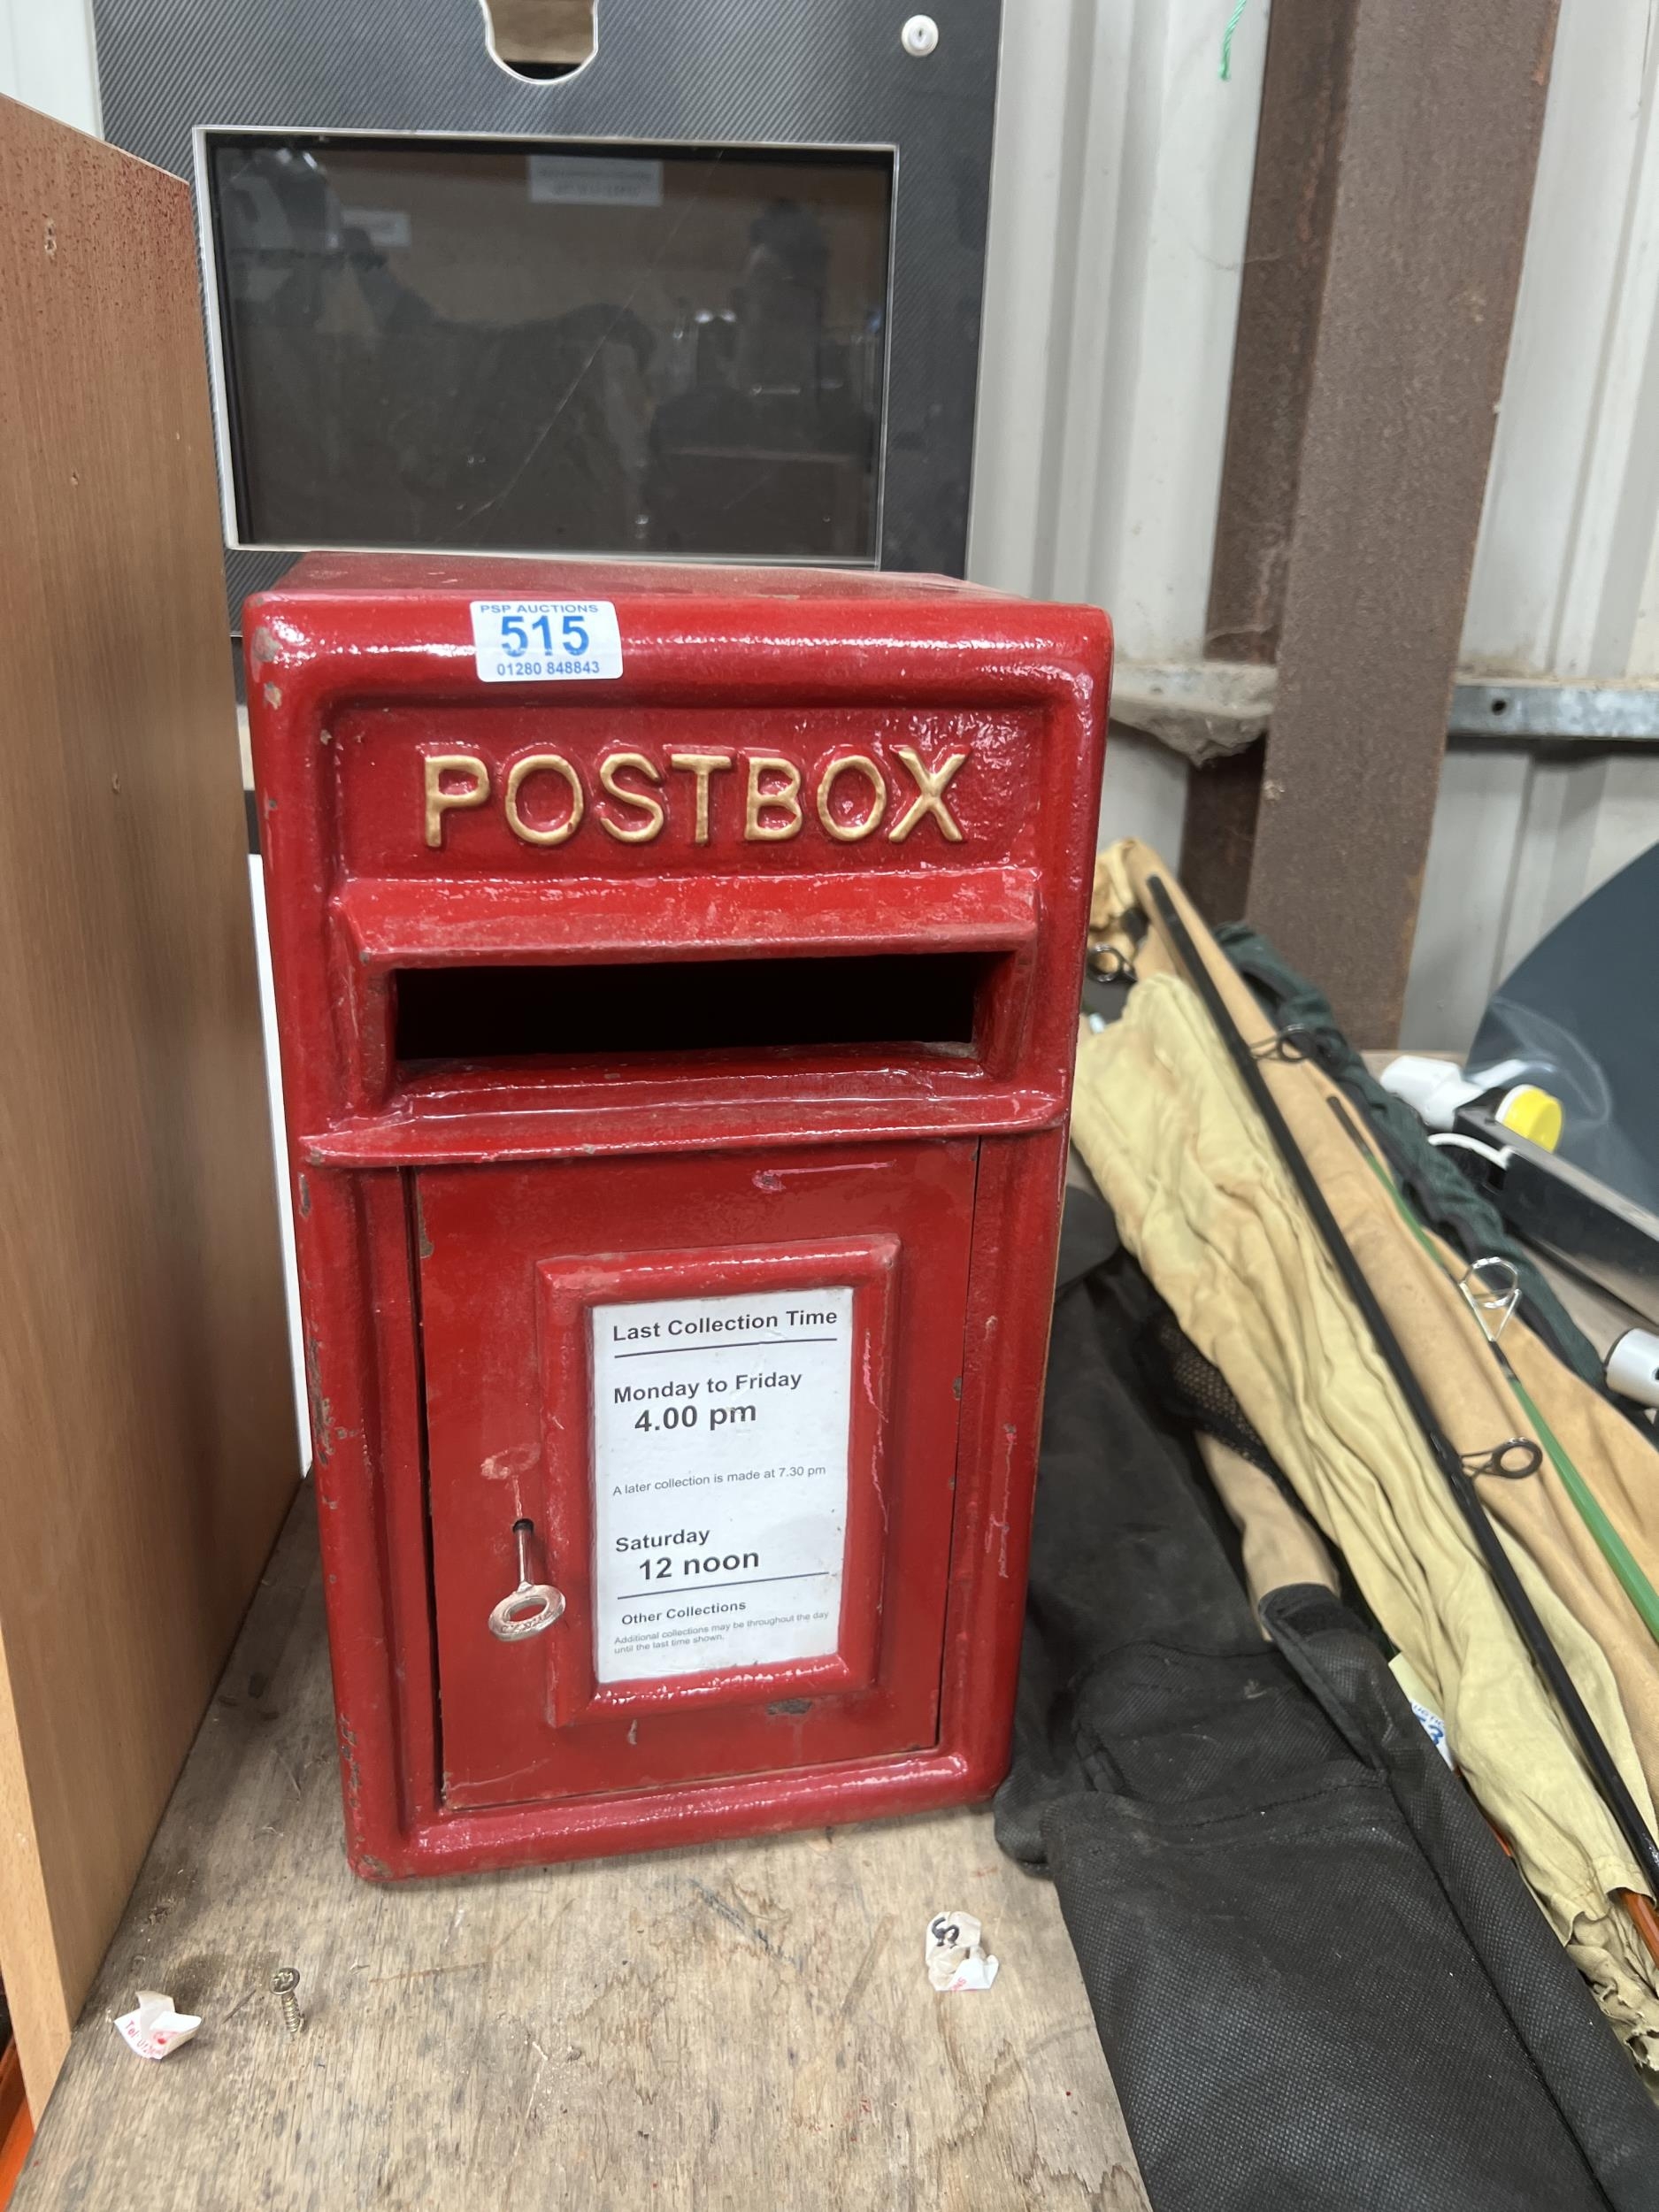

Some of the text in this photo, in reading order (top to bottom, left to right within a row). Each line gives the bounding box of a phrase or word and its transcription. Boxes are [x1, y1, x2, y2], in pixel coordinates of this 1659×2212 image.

[480, 604, 599, 613] PSP AUCTIONS
[501, 615, 590, 657] 515
[496, 661, 600, 676] 01280 848843
[424, 747, 965, 847] POSTBOX
[613, 1310, 838, 1341] Last Collection Time
[614, 1371, 803, 1403] Monday to Friday
[634, 1404, 757, 1432] 4.00 pm
[612, 1465, 826, 1496] A later collection is made at 7.30 pm
[615, 1529, 710, 1553] Saturday
[640, 1551, 759, 1580] 12 noon
[622, 1601, 747, 1625] Other Collections
[614, 1611, 829, 1646] Additional collections may be throughout the day
[614, 1633, 725, 1655] until the last time shown.
